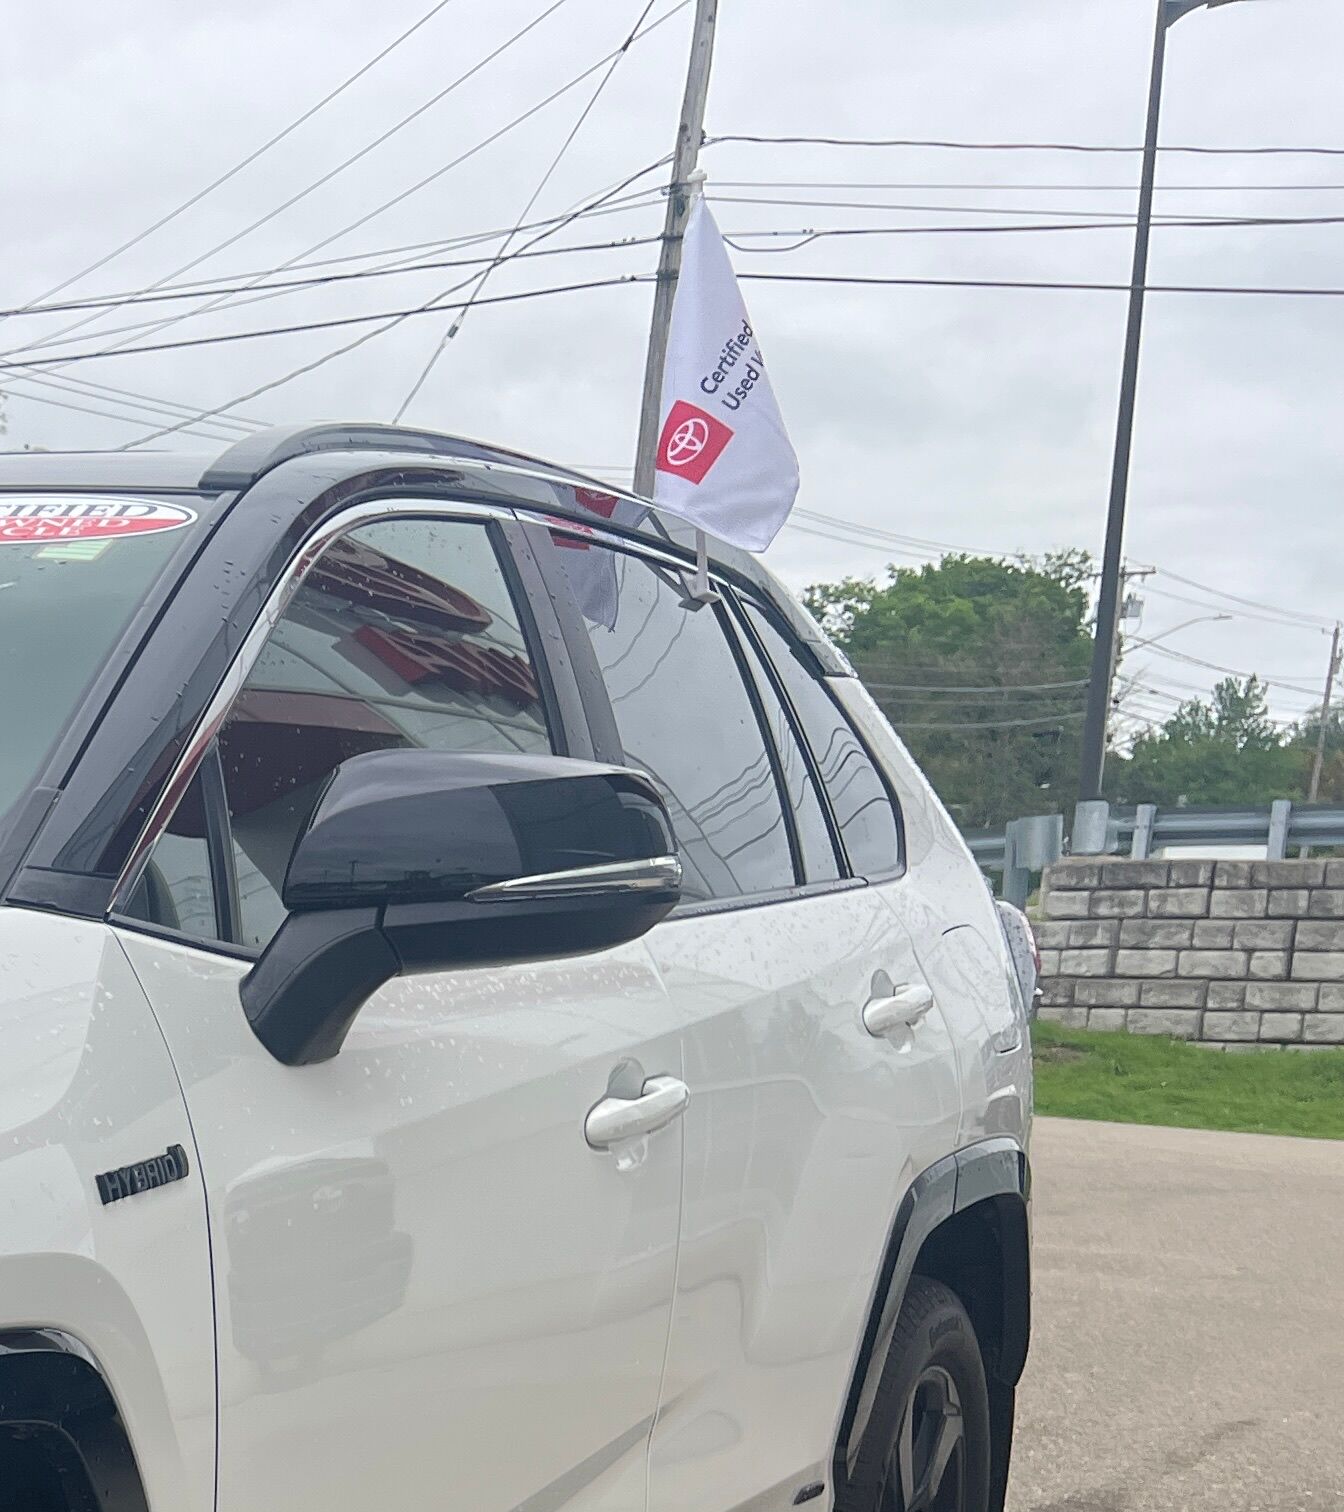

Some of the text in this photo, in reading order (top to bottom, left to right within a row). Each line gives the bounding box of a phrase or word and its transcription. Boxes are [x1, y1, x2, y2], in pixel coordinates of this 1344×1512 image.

[700, 319, 753, 394] Certified
[721, 361, 761, 411] Used
[102, 1153, 178, 1202] HYBRID
